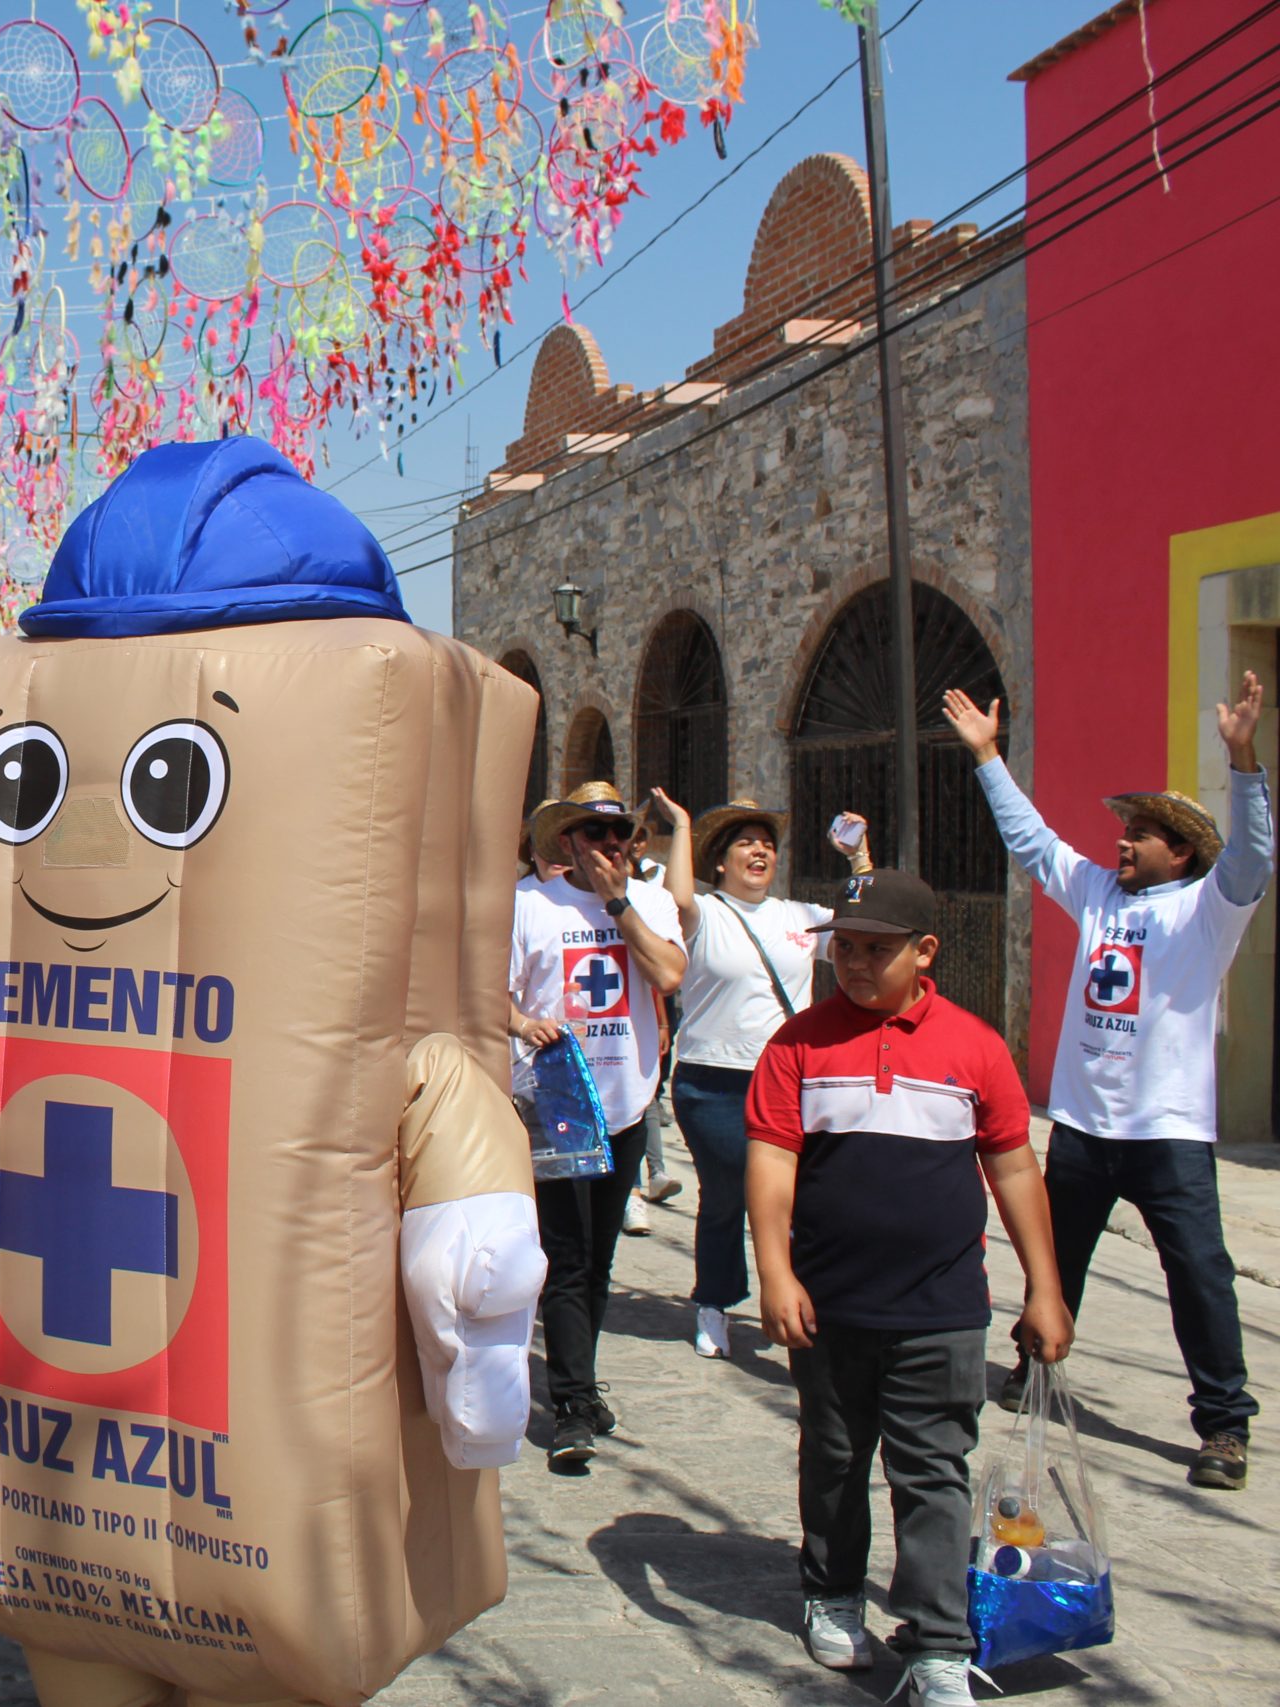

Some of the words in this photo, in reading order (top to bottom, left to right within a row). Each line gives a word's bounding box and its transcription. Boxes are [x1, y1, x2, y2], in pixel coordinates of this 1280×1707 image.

[600, 1022, 630, 1037] AZUL
[1106, 1017, 1137, 1033] AZUL
[92, 1418, 231, 1509] AZUL
[212, 1432, 229, 1444] MR
[2, 1484, 86, 1527] PORTLAND
[92, 1508, 136, 1537] TIPO
[165, 1520, 269, 1570] COMPUESTO
[216, 1508, 233, 1521] MR
[15, 1545, 78, 1573] CONTENIDO
[80, 1561, 112, 1580] NETO
[116, 1569, 131, 1585] 50
[134, 1573, 151, 1591] kg
[33, 1599, 51, 1612] UN
[104, 1613, 124, 1628] DE
[126, 1617, 183, 1641] CALIDAD
[185, 1632, 228, 1650] DESDE
[42, 1572, 112, 1607] 100%
[120, 1588, 253, 1639] MEXICANA
